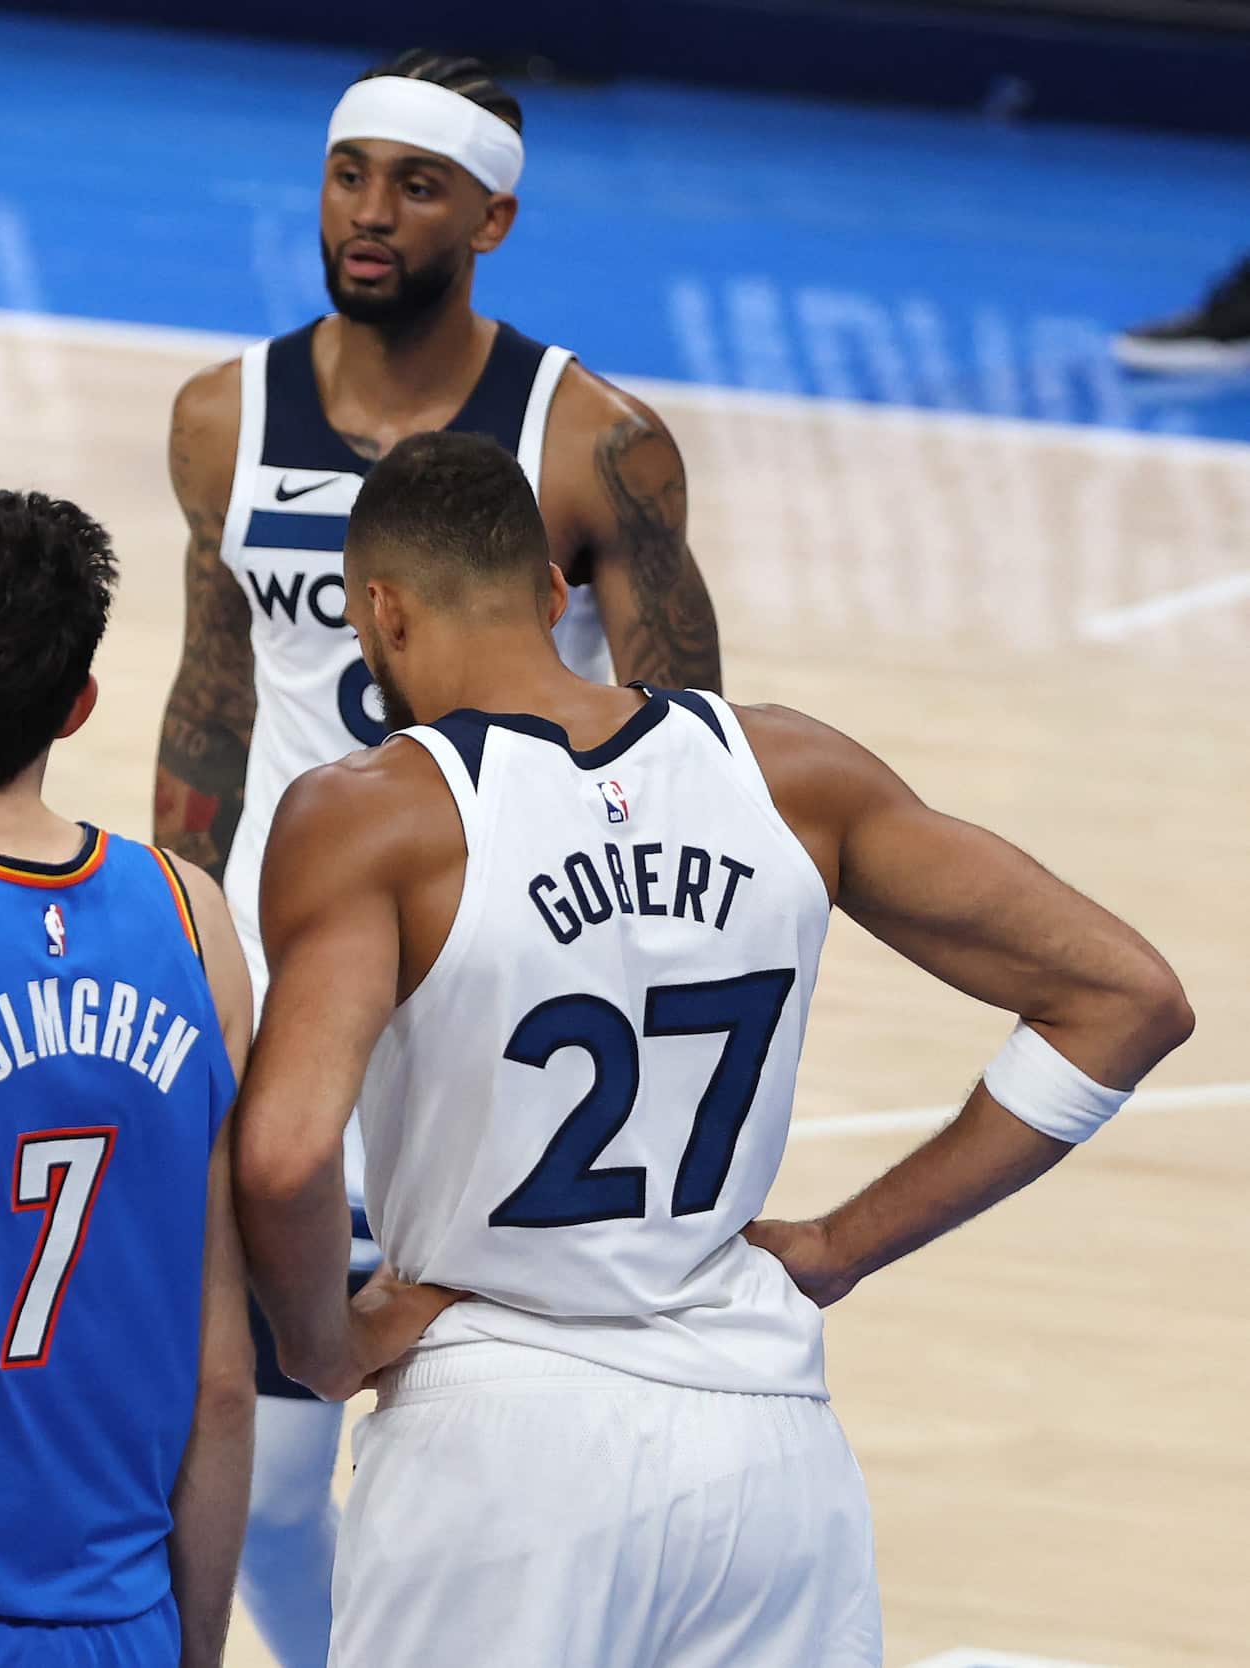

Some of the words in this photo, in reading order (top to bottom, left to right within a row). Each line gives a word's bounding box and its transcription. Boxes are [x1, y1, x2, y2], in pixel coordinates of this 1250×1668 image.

[528, 842, 754, 945] GOBERT
[489, 968, 796, 1227] 27
[0, 1125, 118, 1369] 7
